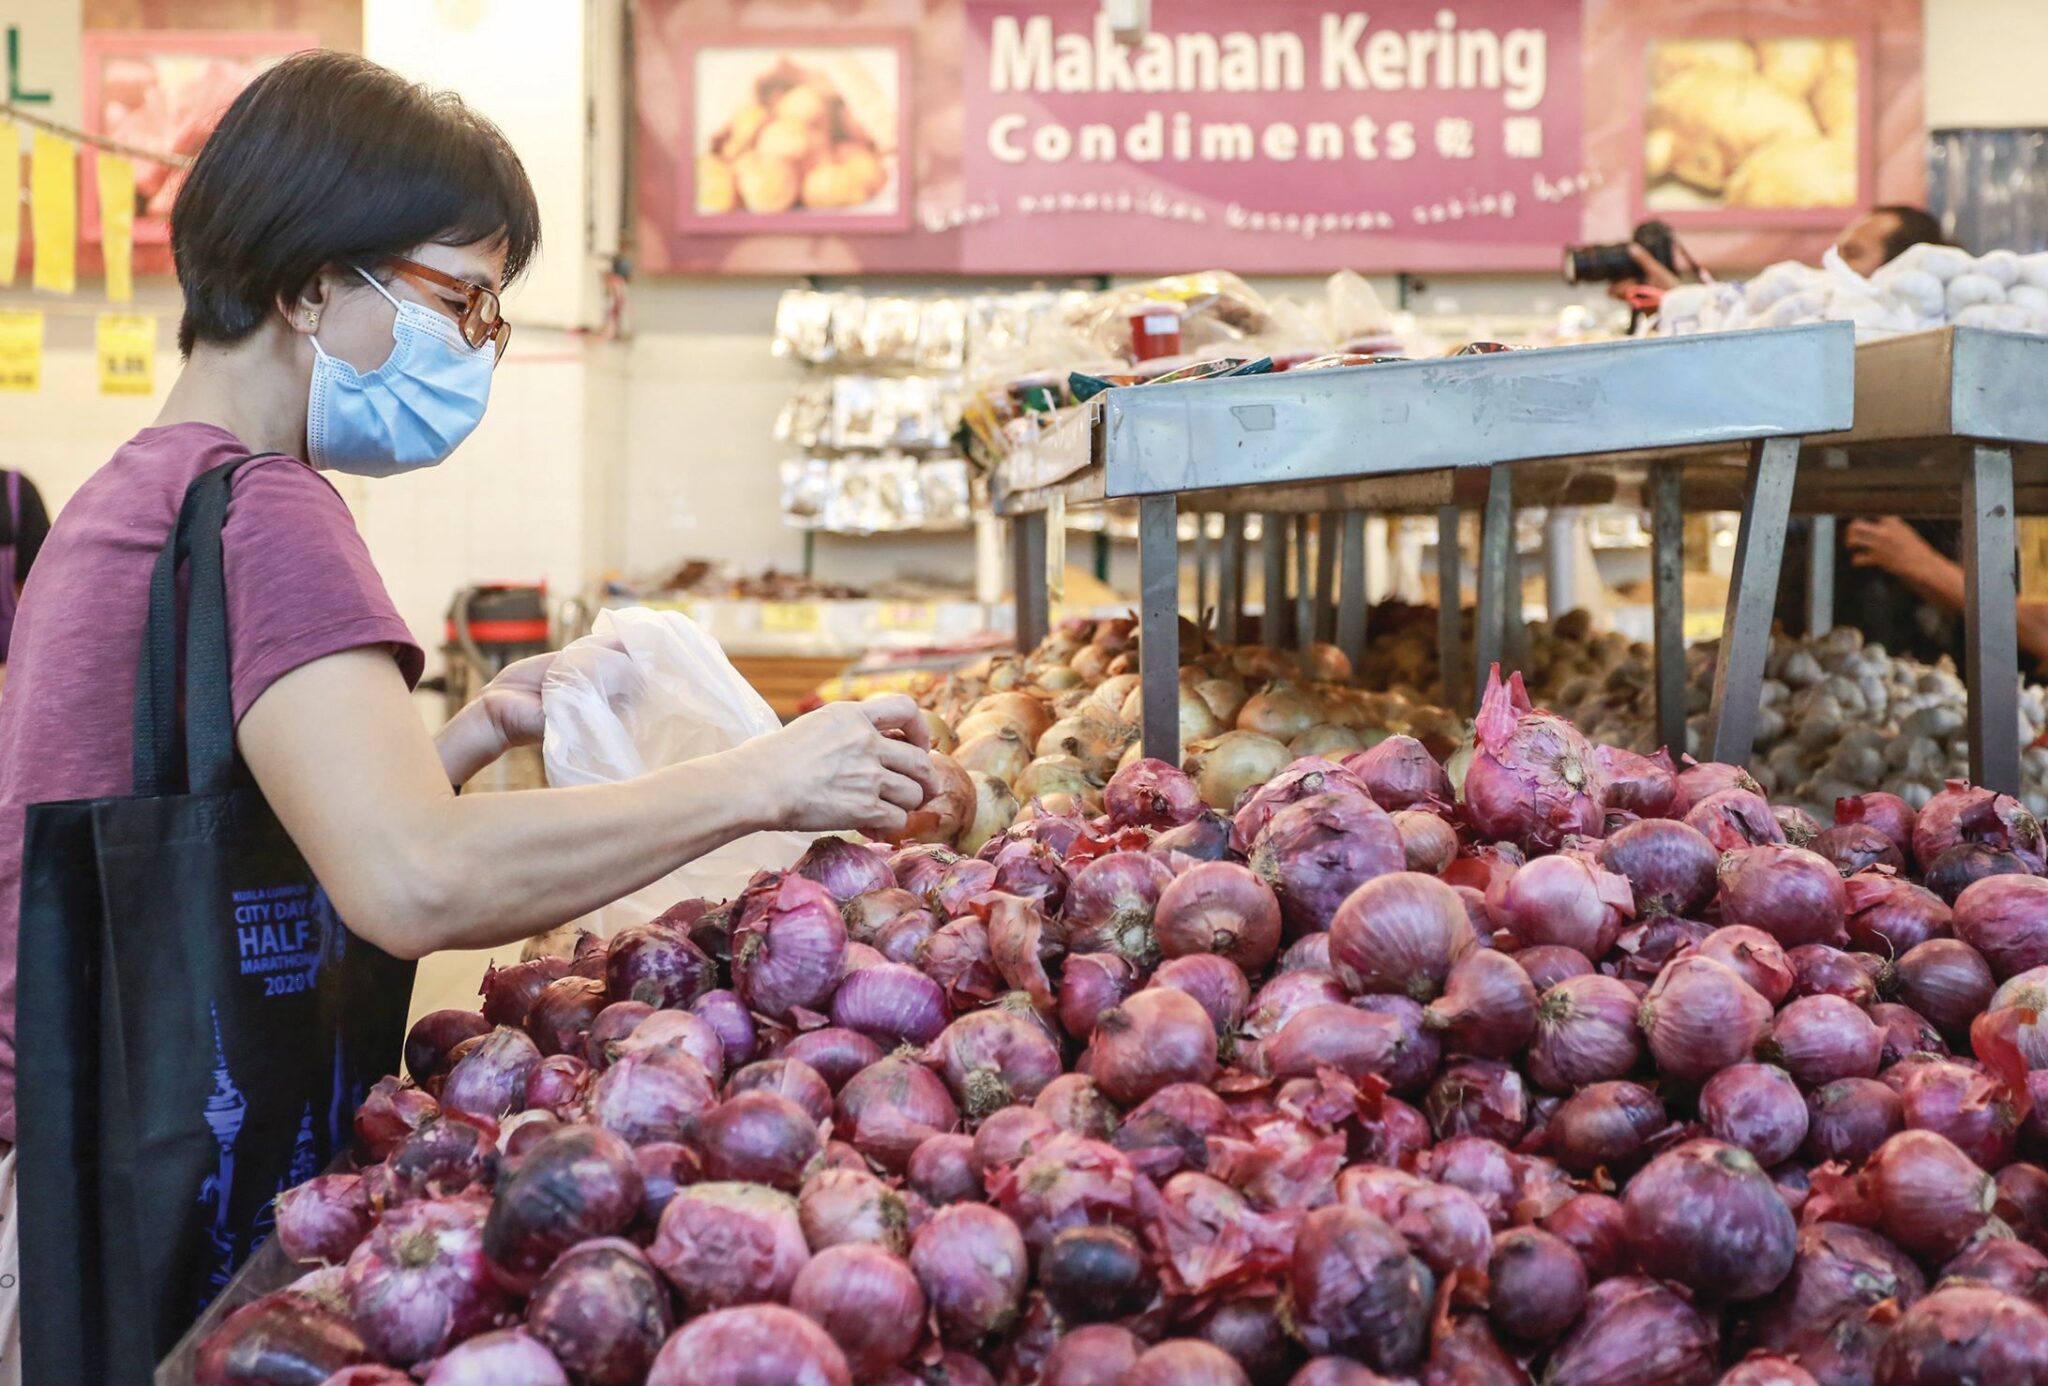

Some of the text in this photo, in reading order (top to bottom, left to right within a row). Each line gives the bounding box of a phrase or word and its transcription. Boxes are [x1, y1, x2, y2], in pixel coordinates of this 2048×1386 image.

[990, 9, 1547, 110] Makanan Kering
[987, 111, 1416, 163] Condiments
[235, 901, 307, 924] CITY DAY
[238, 919, 310, 957] HALF
[241, 952, 318, 975] MARATHON
[264, 973, 306, 996] 2020
